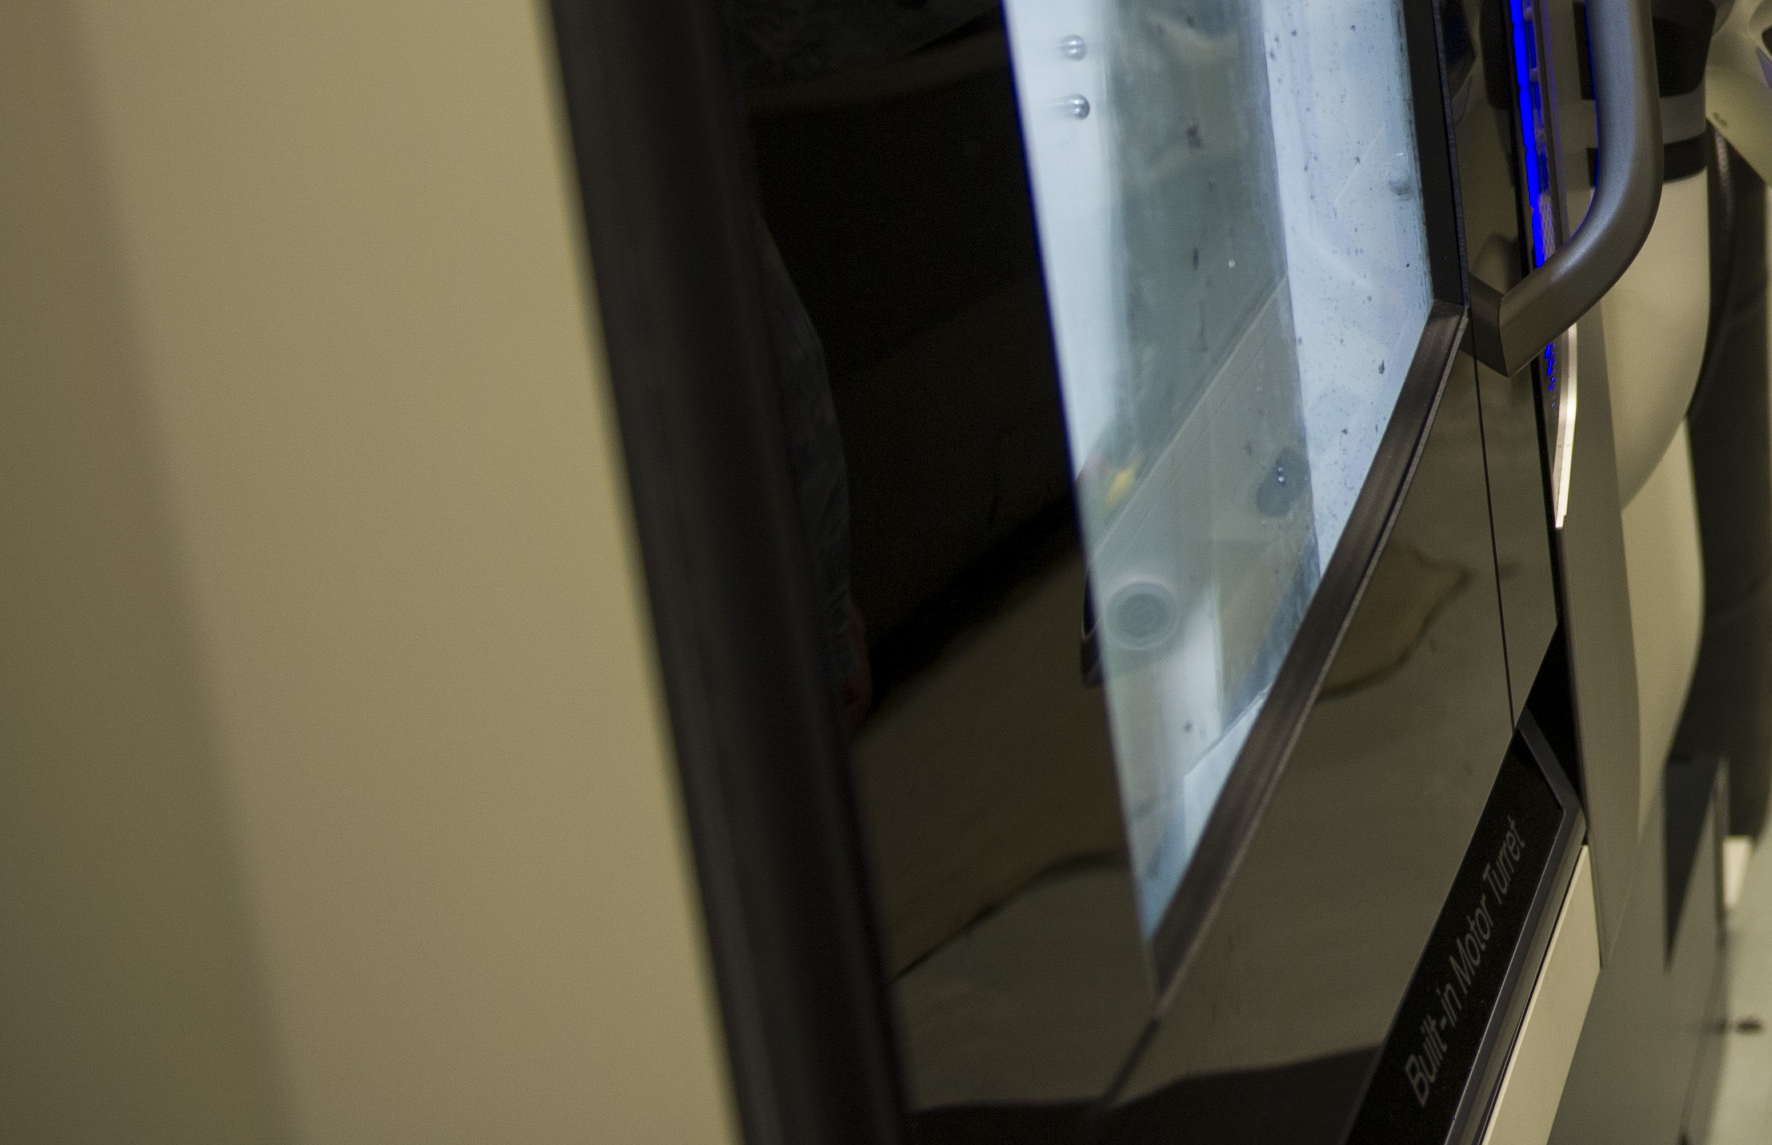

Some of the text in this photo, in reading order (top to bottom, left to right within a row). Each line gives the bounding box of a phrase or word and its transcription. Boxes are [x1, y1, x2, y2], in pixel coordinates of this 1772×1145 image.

[1405, 816, 1525, 1107] Built-in Motor Turret
